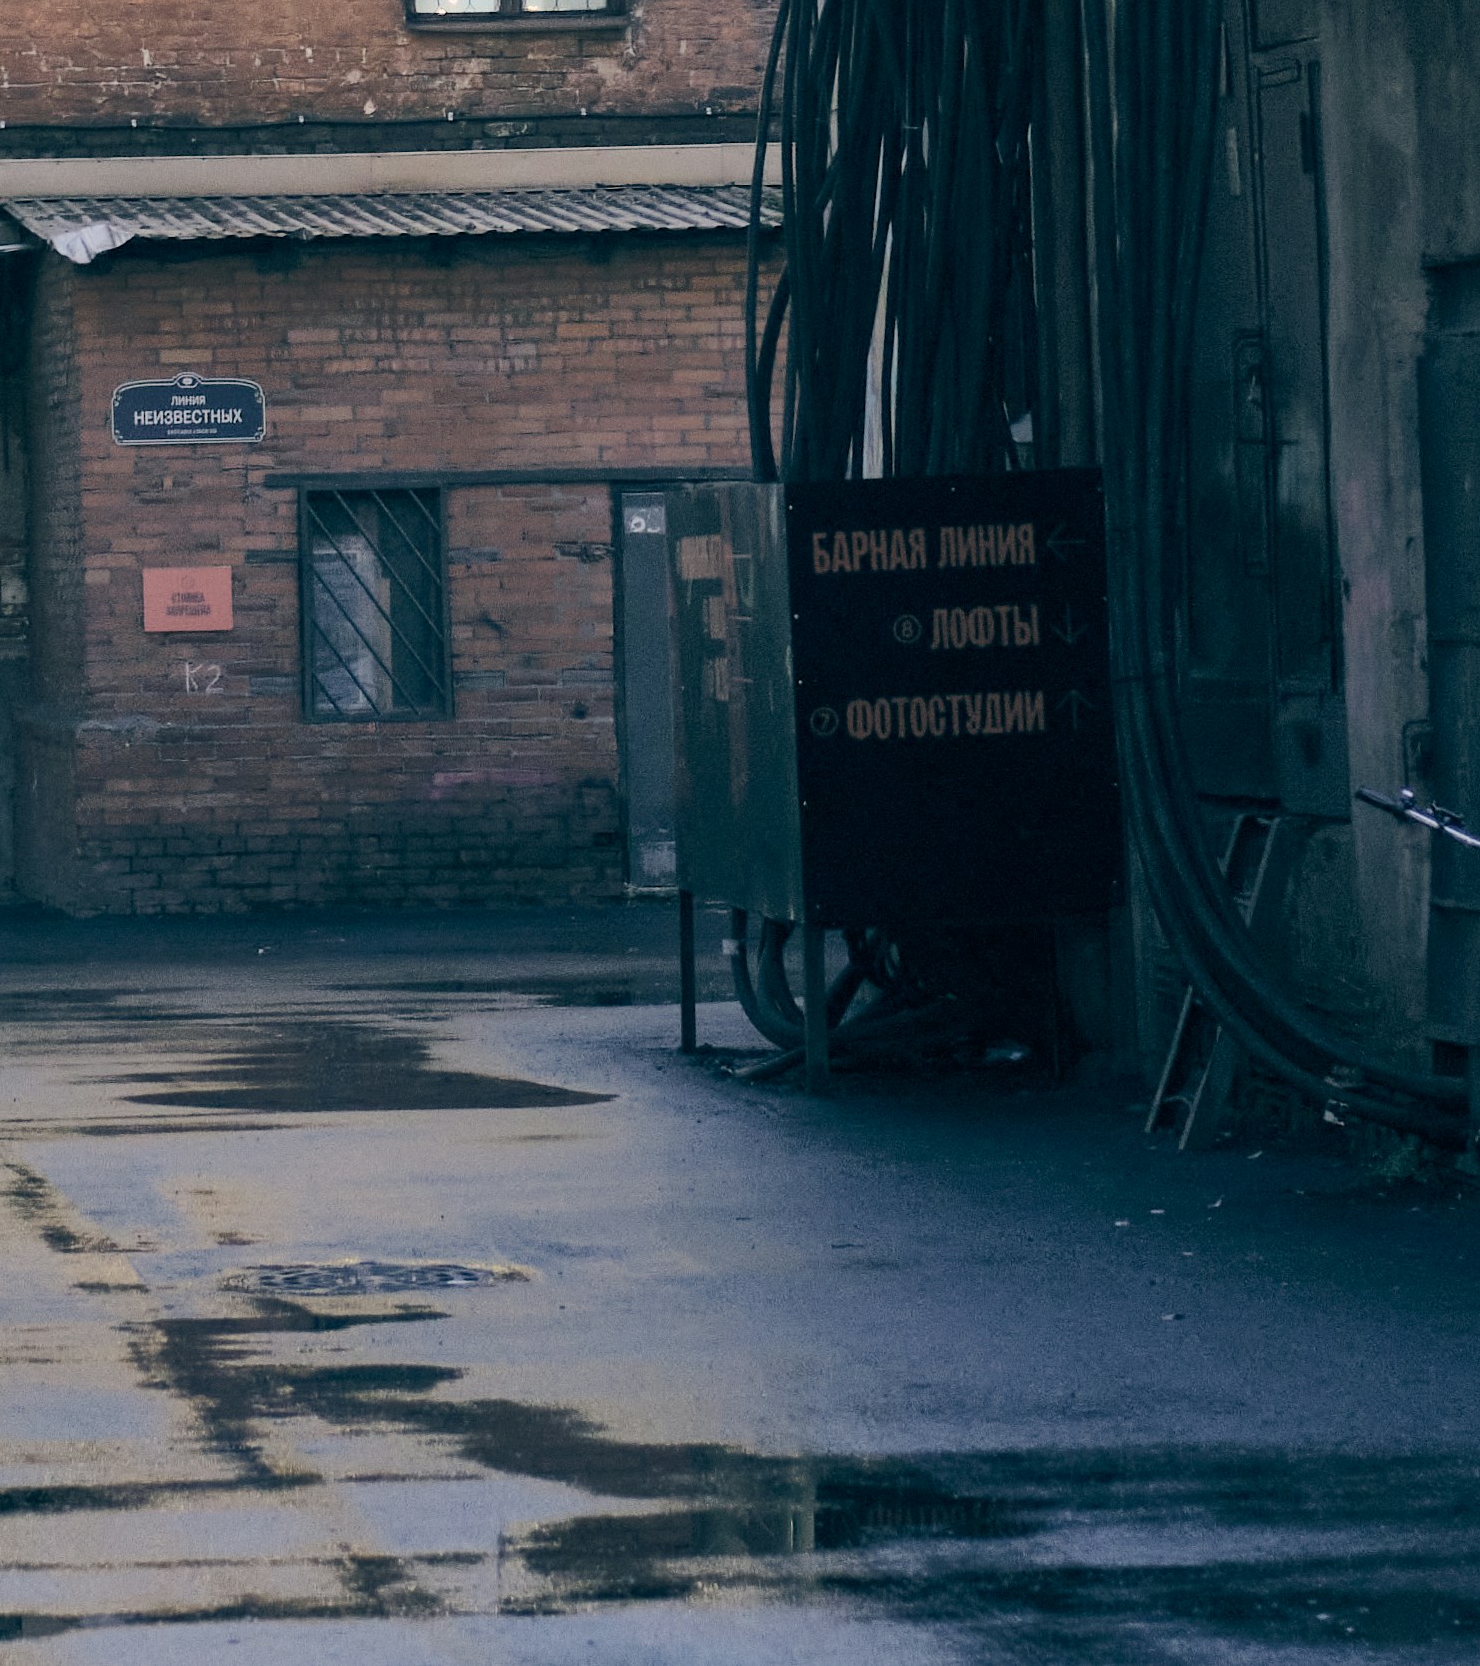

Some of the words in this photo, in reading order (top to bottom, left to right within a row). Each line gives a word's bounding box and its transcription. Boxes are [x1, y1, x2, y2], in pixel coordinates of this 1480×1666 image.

[133, 409, 243, 426] НЕИЗВЕСТНЫХ
[170, 395, 206, 407] ЛИНИЯ
[813, 529, 927, 573] БАРНАЯ
[938, 524, 1035, 568] ЛИНИЯ
[930, 606, 1039, 649] ЛОФТЫ
[847, 692, 1044, 739] ФОТОСТУДИИ
